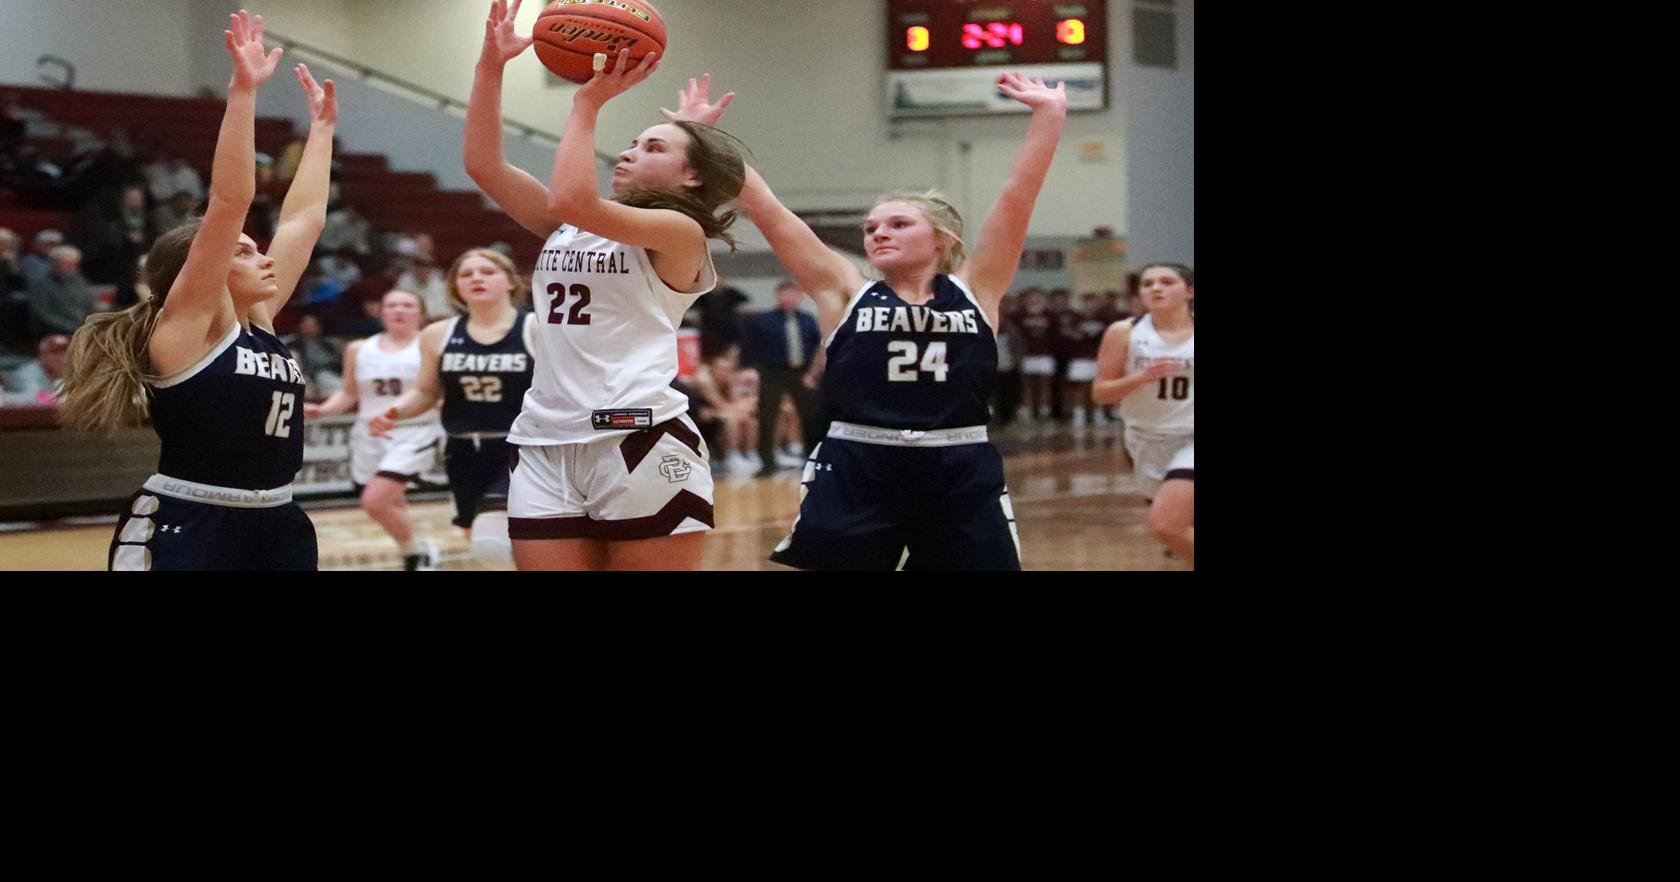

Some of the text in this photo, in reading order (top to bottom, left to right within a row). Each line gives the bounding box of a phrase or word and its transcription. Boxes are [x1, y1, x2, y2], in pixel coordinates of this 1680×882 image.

[562, 251, 630, 274] CENTRAL
[546, 283, 592, 325] 22
[856, 306, 979, 334] BEAVERS
[442, 352, 527, 373] BEAVERS
[887, 340, 949, 382] 24
[460, 375, 503, 402] 22
[1157, 376, 1189, 401] 10
[265, 390, 296, 438] 12
